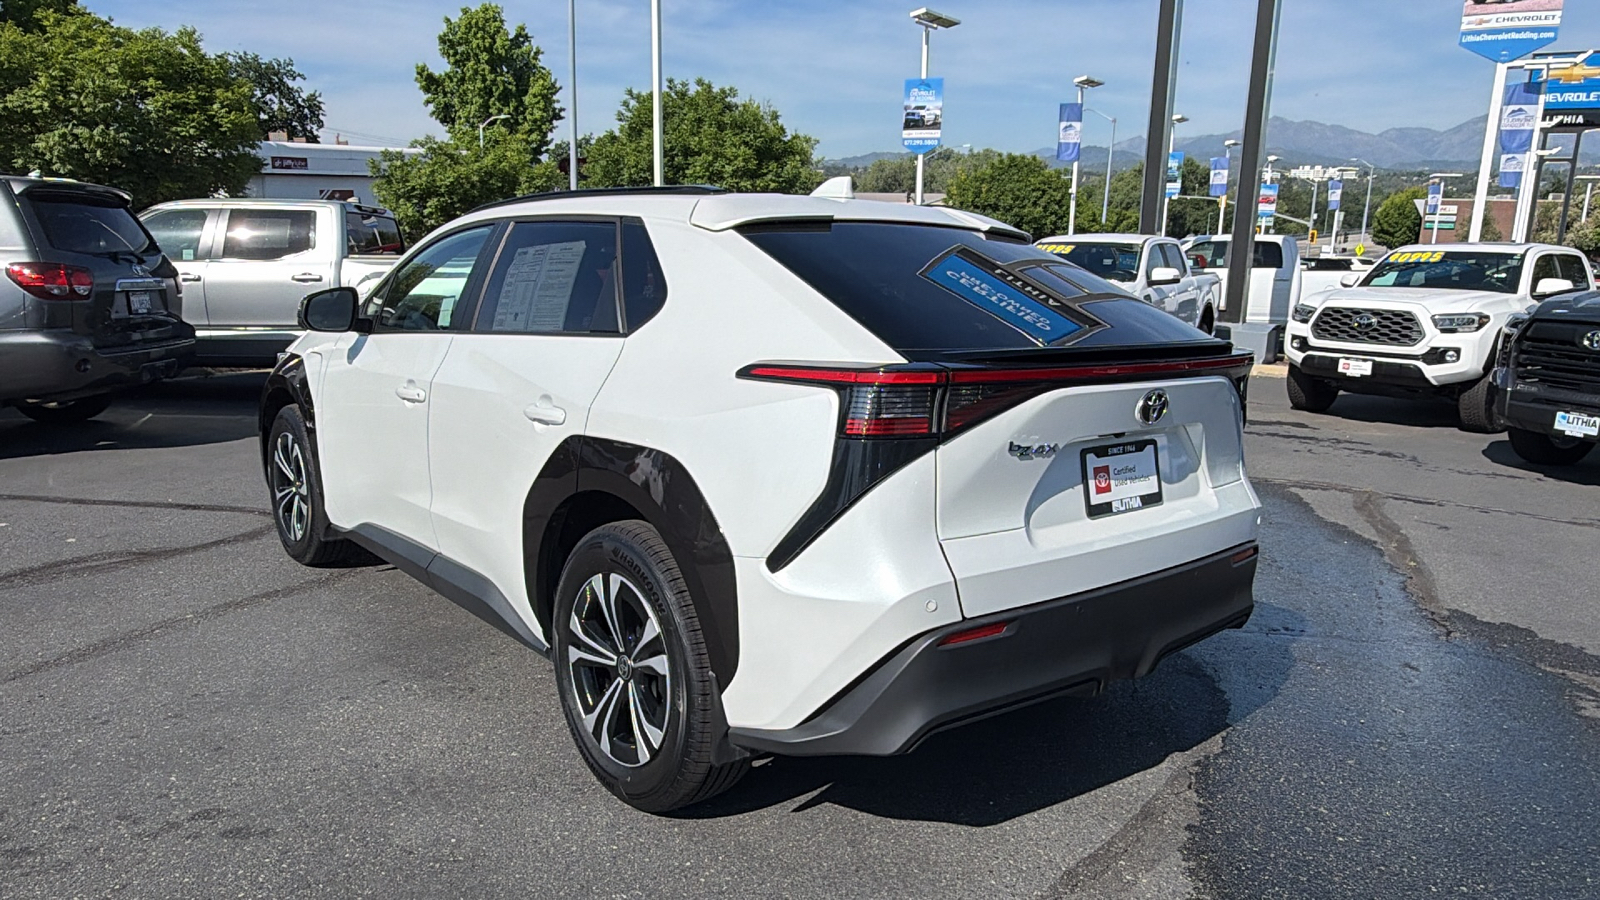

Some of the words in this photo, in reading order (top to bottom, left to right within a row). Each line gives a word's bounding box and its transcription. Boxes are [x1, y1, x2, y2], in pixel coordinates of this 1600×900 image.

[1495, 14, 1556, 23] CHEVROLET
[1461, 31, 1555, 42] LithiaChevroletRedding.com
[1566, 415, 1598, 429] LITHIA
[1107, 446, 1124, 456] SINCE
[1113, 465, 1136, 476] Certified
[1114, 478, 1128, 487] Used
[1129, 474, 1151, 484] Vehicles
[1118, 496, 1143, 511] LITHIA
[619, 551, 667, 615] Hankook
